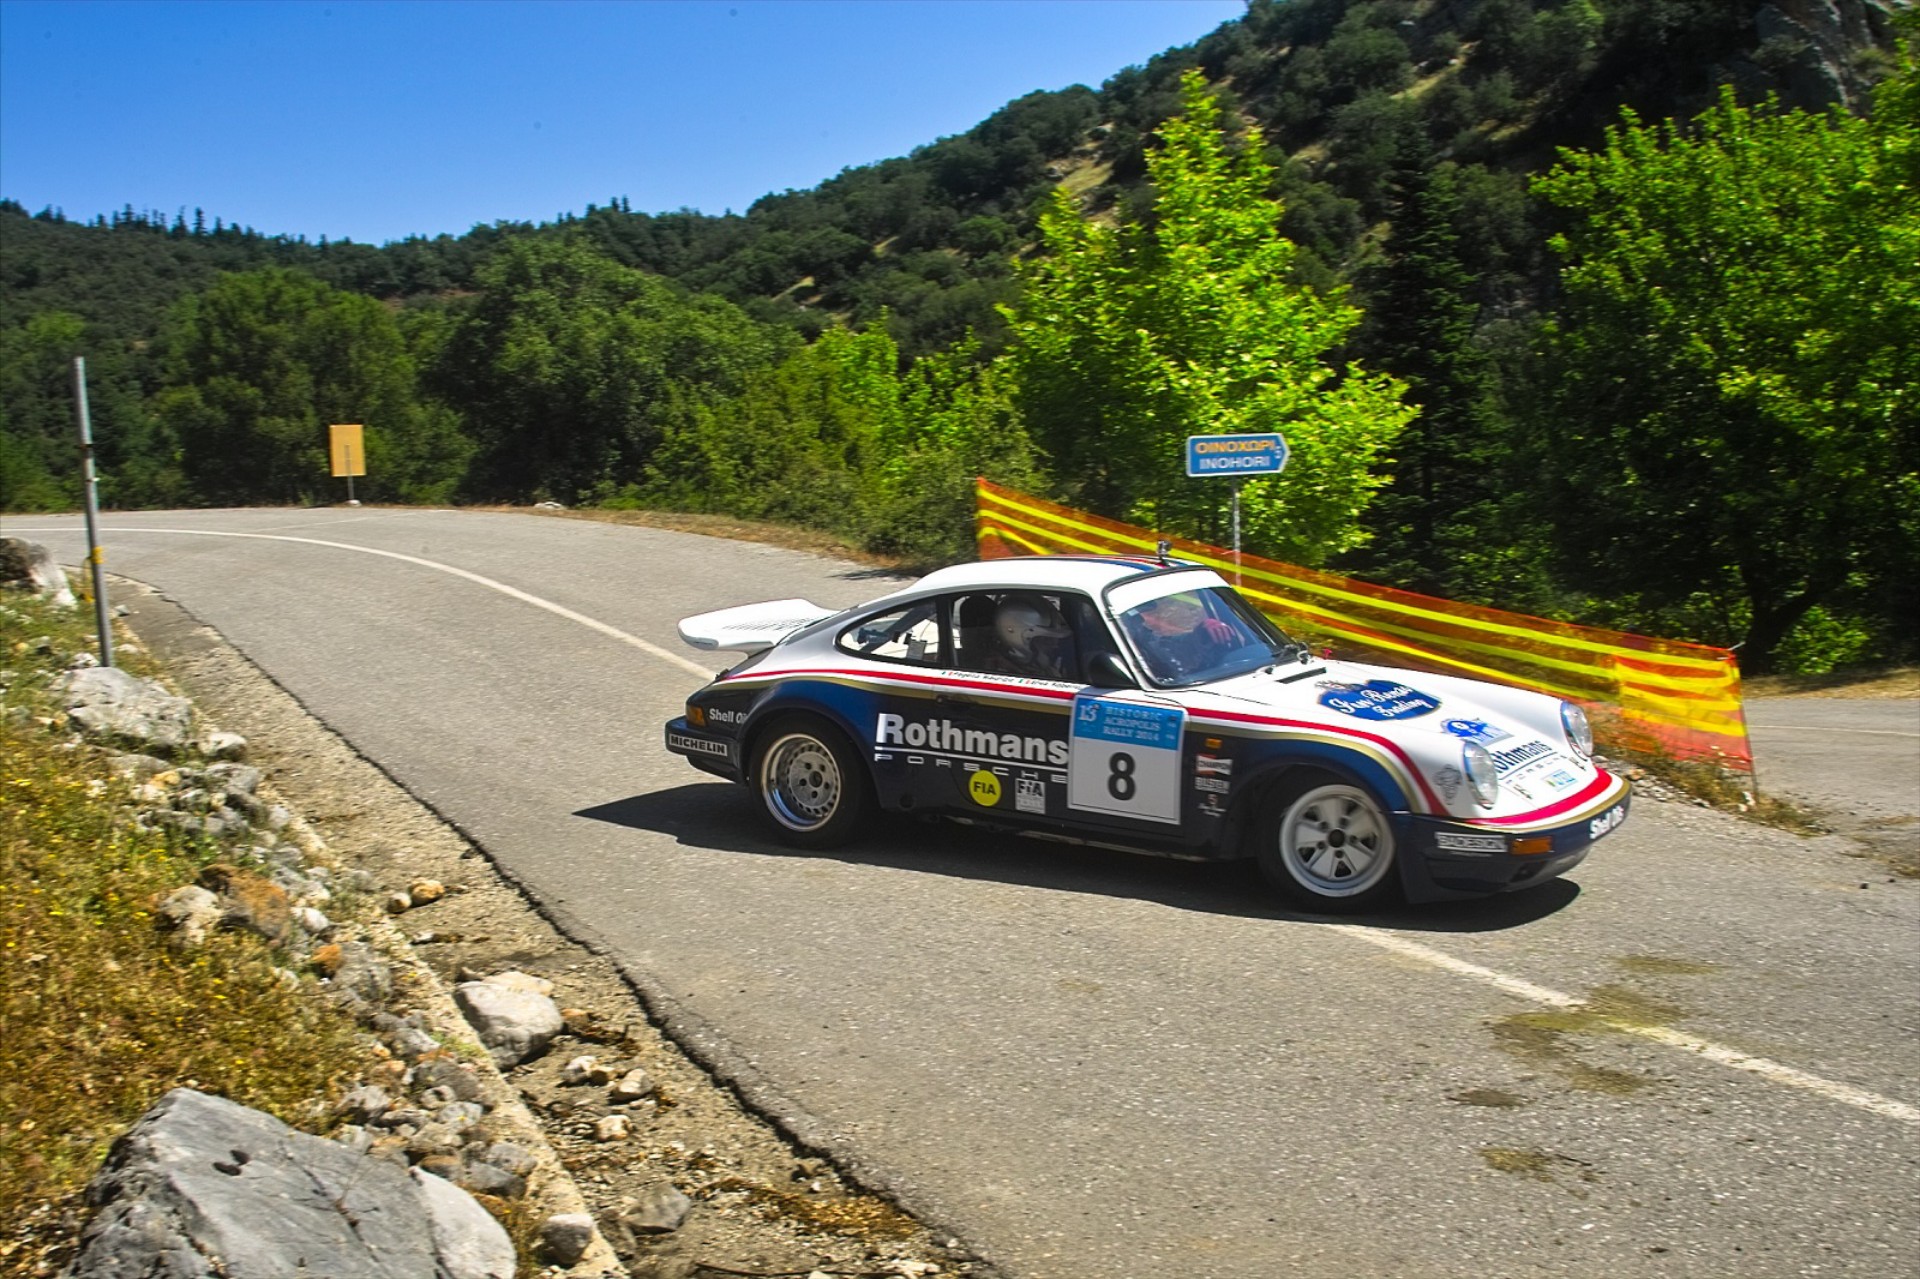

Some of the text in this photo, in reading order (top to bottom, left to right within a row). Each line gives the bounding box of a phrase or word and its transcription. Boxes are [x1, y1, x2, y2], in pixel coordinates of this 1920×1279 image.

[709, 707, 734, 723] Shell
[1105, 706, 1163, 721] HISTORIC
[670, 735, 726, 754] MICHELIN
[875, 713, 1069, 765] Rothmans
[874, 753, 1068, 784] PORSCHE
[1489, 740, 1553, 774] othmans
[973, 781, 996, 796] FIA
[1107, 751, 1136, 801] 8
